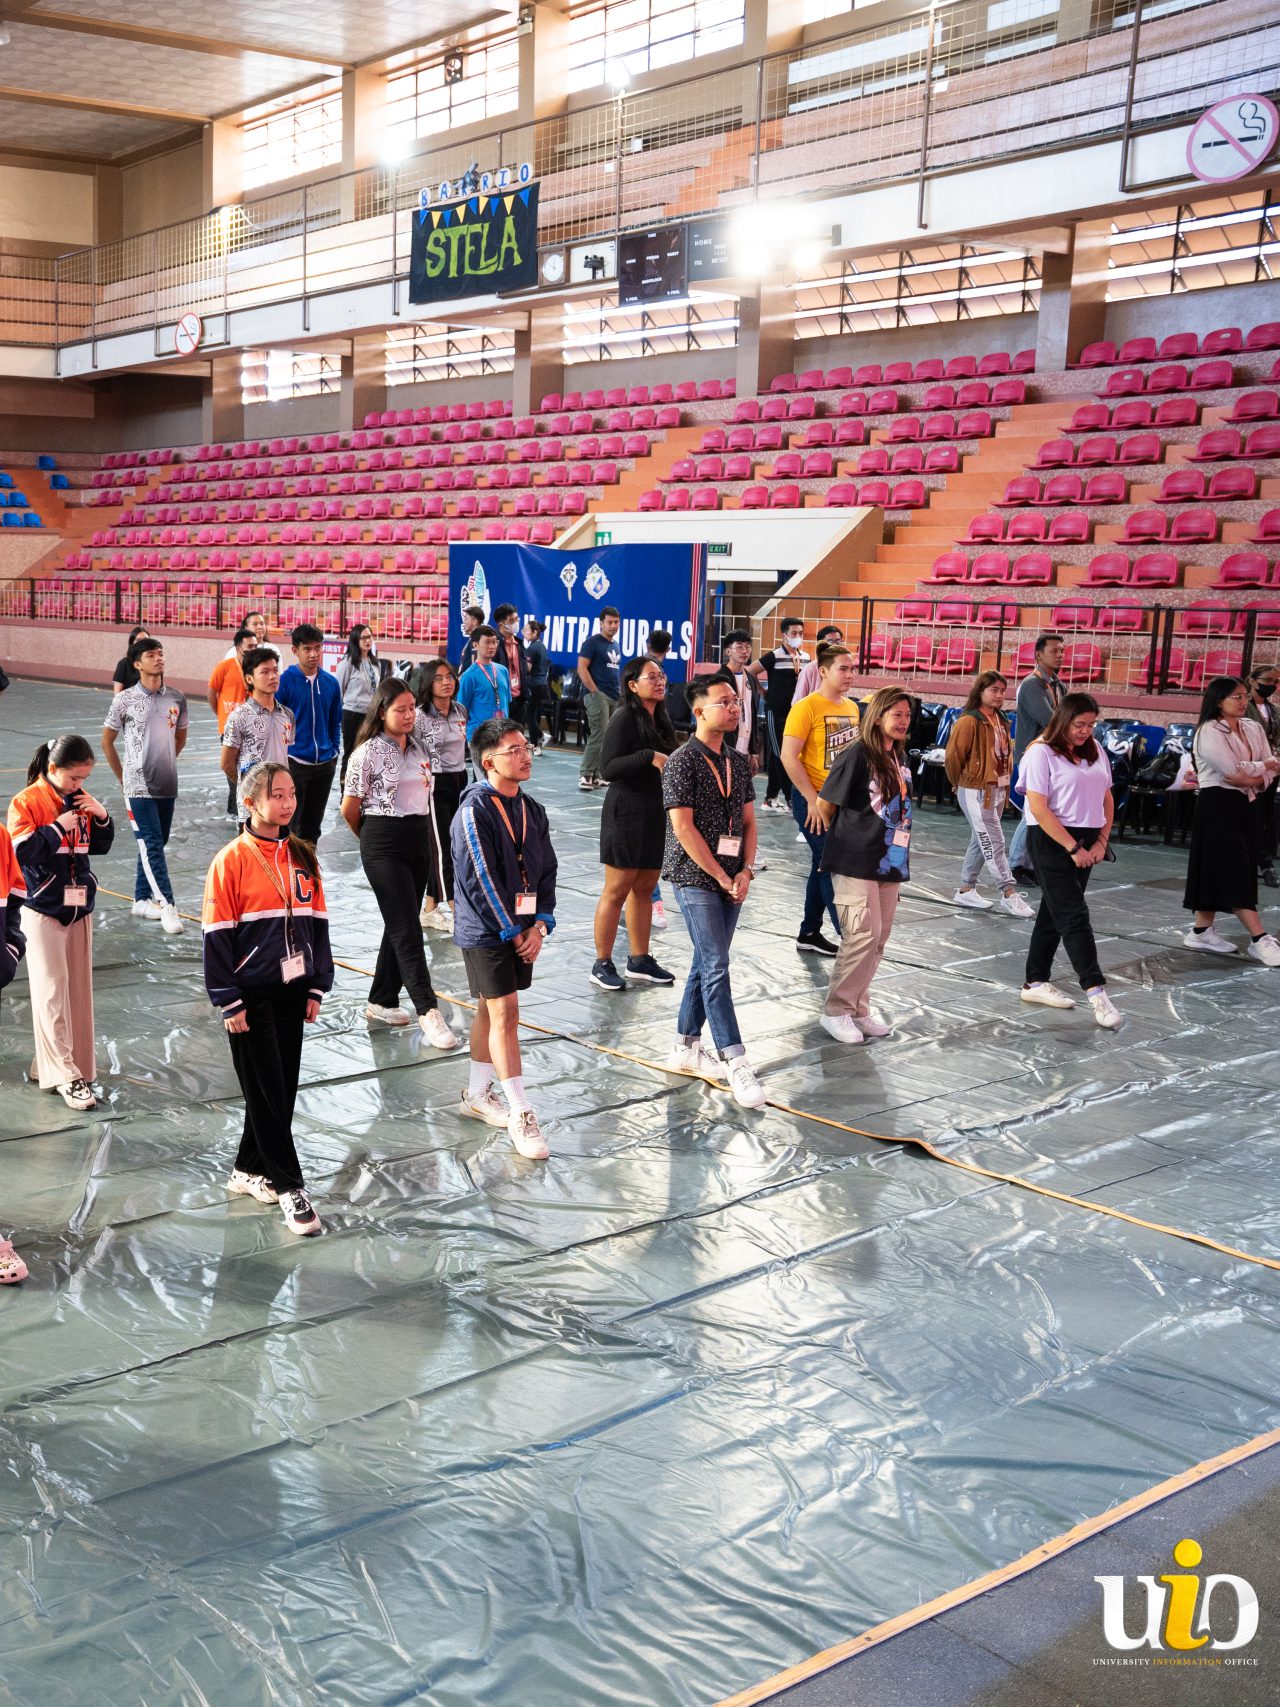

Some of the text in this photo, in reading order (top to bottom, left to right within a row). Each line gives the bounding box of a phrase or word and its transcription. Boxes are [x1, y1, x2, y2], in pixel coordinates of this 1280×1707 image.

[426, 215, 523, 278] STELA
[543, 614, 693, 661] INTRURLS
[294, 868, 313, 904] C
